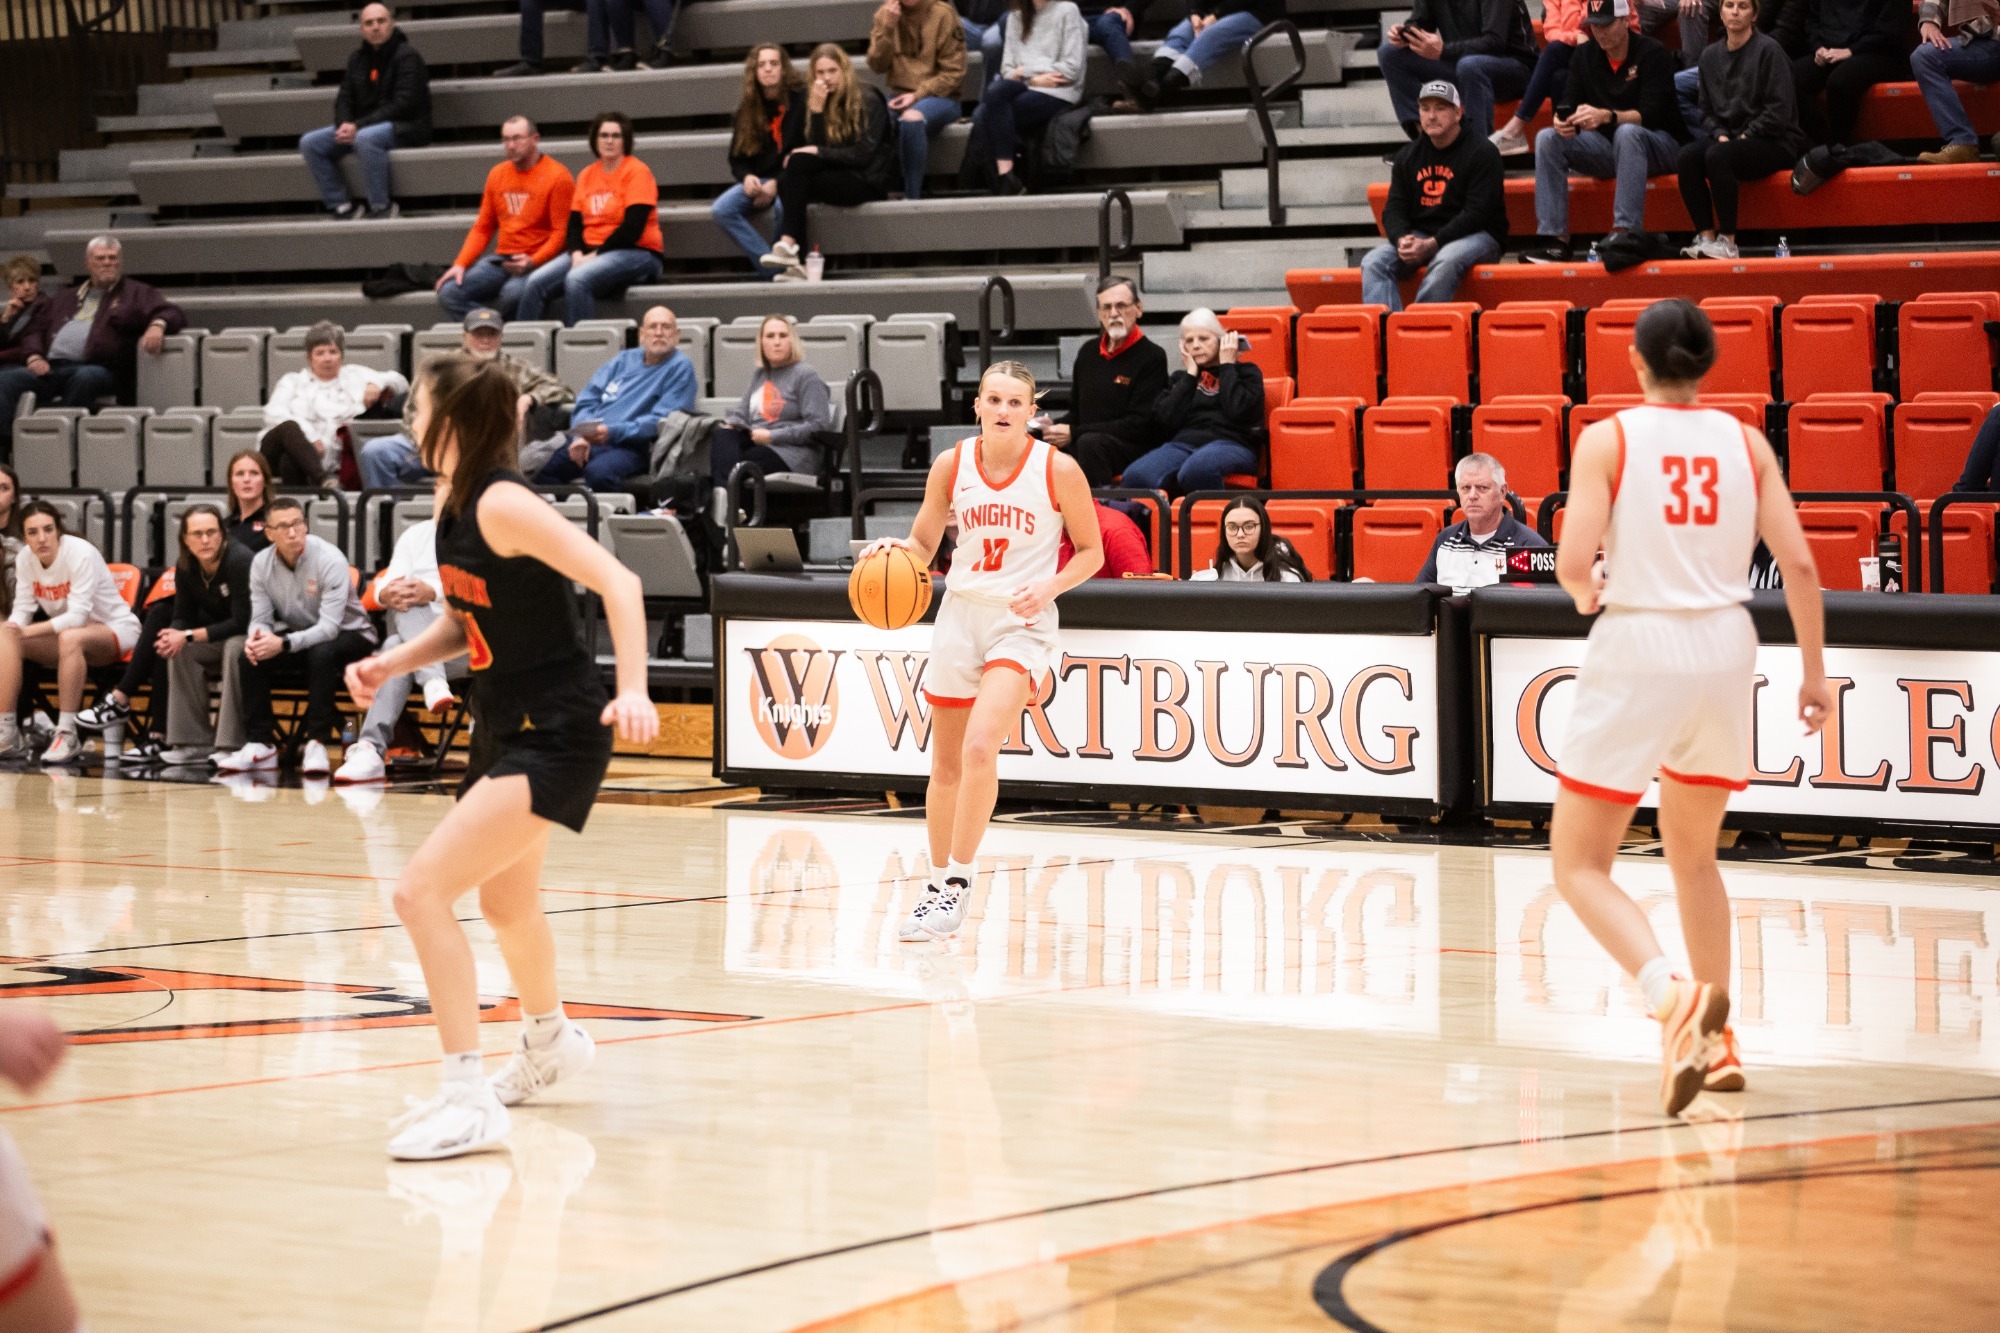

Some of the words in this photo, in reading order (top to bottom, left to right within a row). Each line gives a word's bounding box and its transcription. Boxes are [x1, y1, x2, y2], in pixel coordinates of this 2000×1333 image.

[1662, 455, 1719, 526] 33
[962, 503, 1036, 536] KNIGHTS
[971, 537, 1010, 572] 10
[1530, 552, 1555, 571] POSS
[742, 647, 848, 750] W
[758, 696, 832, 730] Knights
[854, 648, 1420, 776] WRTBURG
[1516, 665, 2000, 796] CLLE
